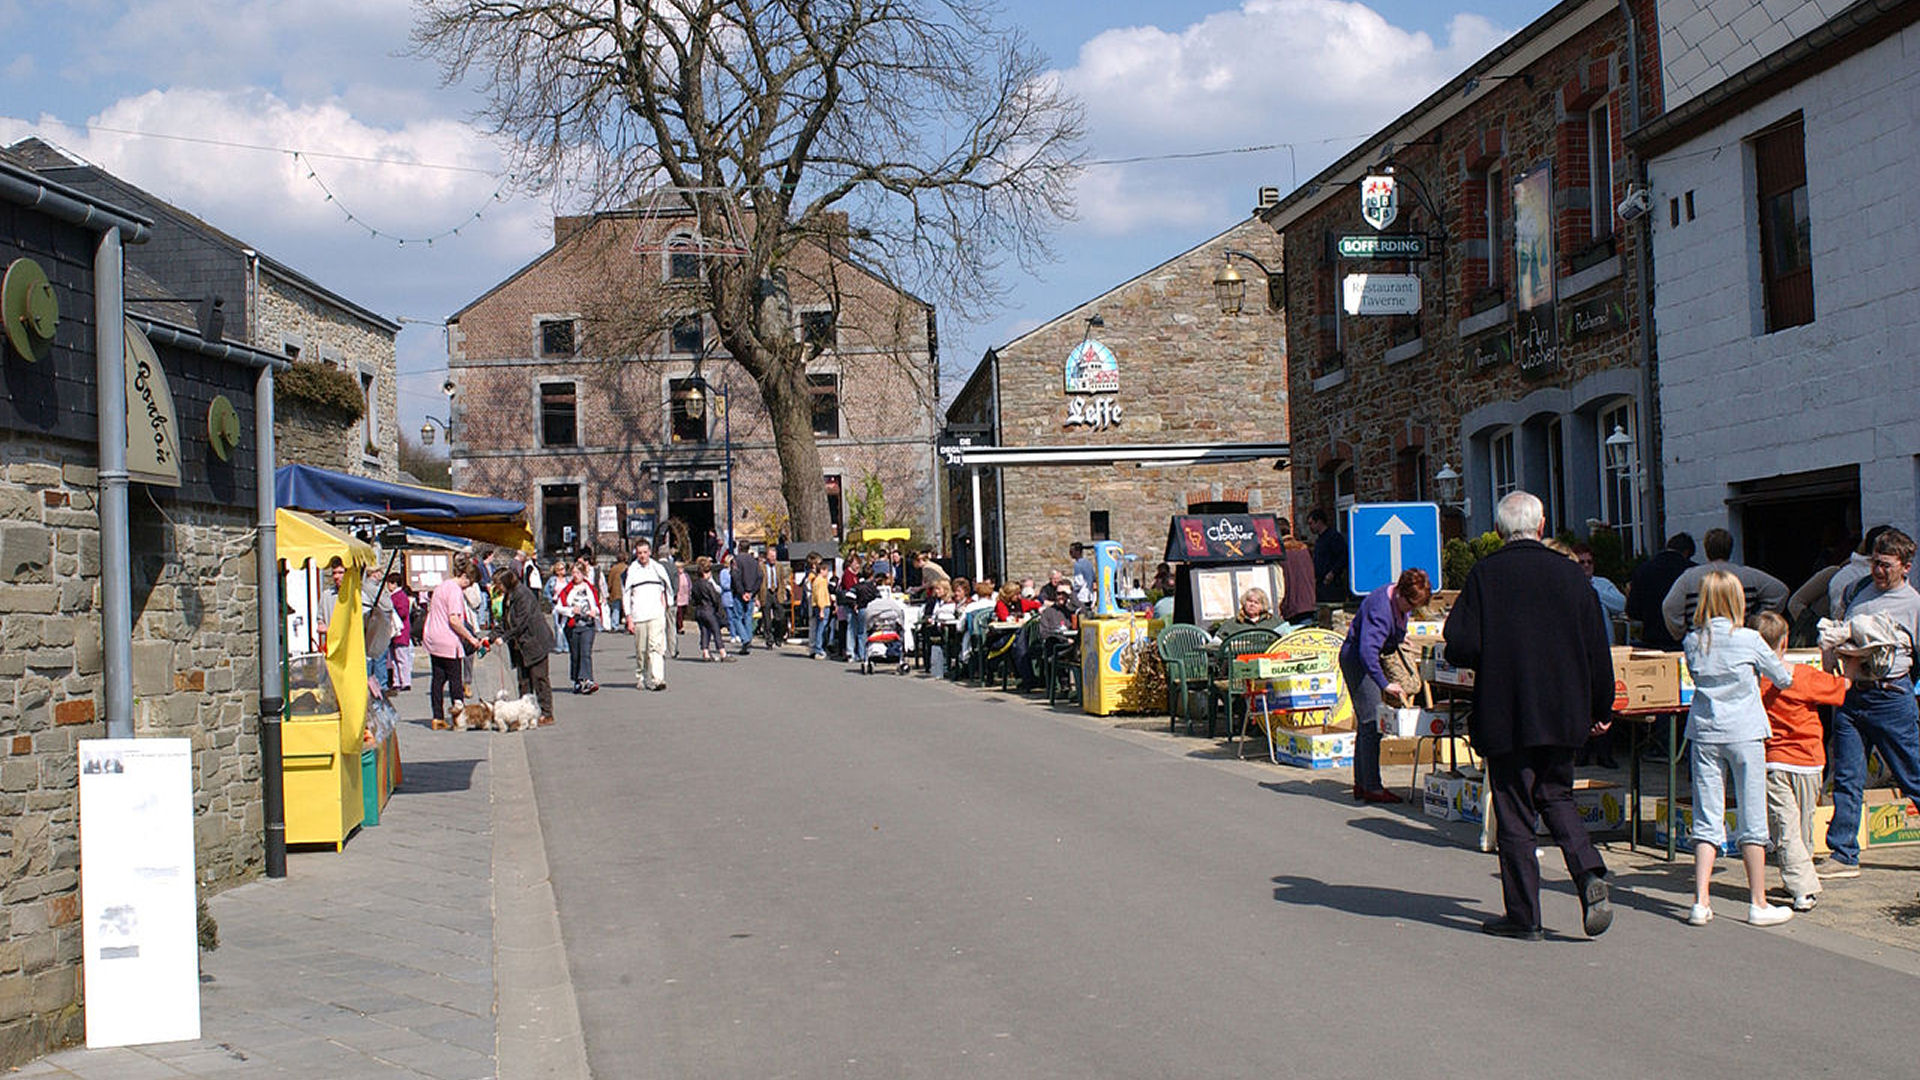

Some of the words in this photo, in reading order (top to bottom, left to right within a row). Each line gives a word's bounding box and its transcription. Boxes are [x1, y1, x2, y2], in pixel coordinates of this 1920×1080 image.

[1344, 240, 1419, 252] BOFFERDING
[1361, 295, 1405, 306] Taverne
[1065, 396, 1122, 430] Leffe
[1220, 518, 1244, 533] Au
[1271, 664, 1297, 675] BLACK
[1305, 662, 1319, 671] CAT
